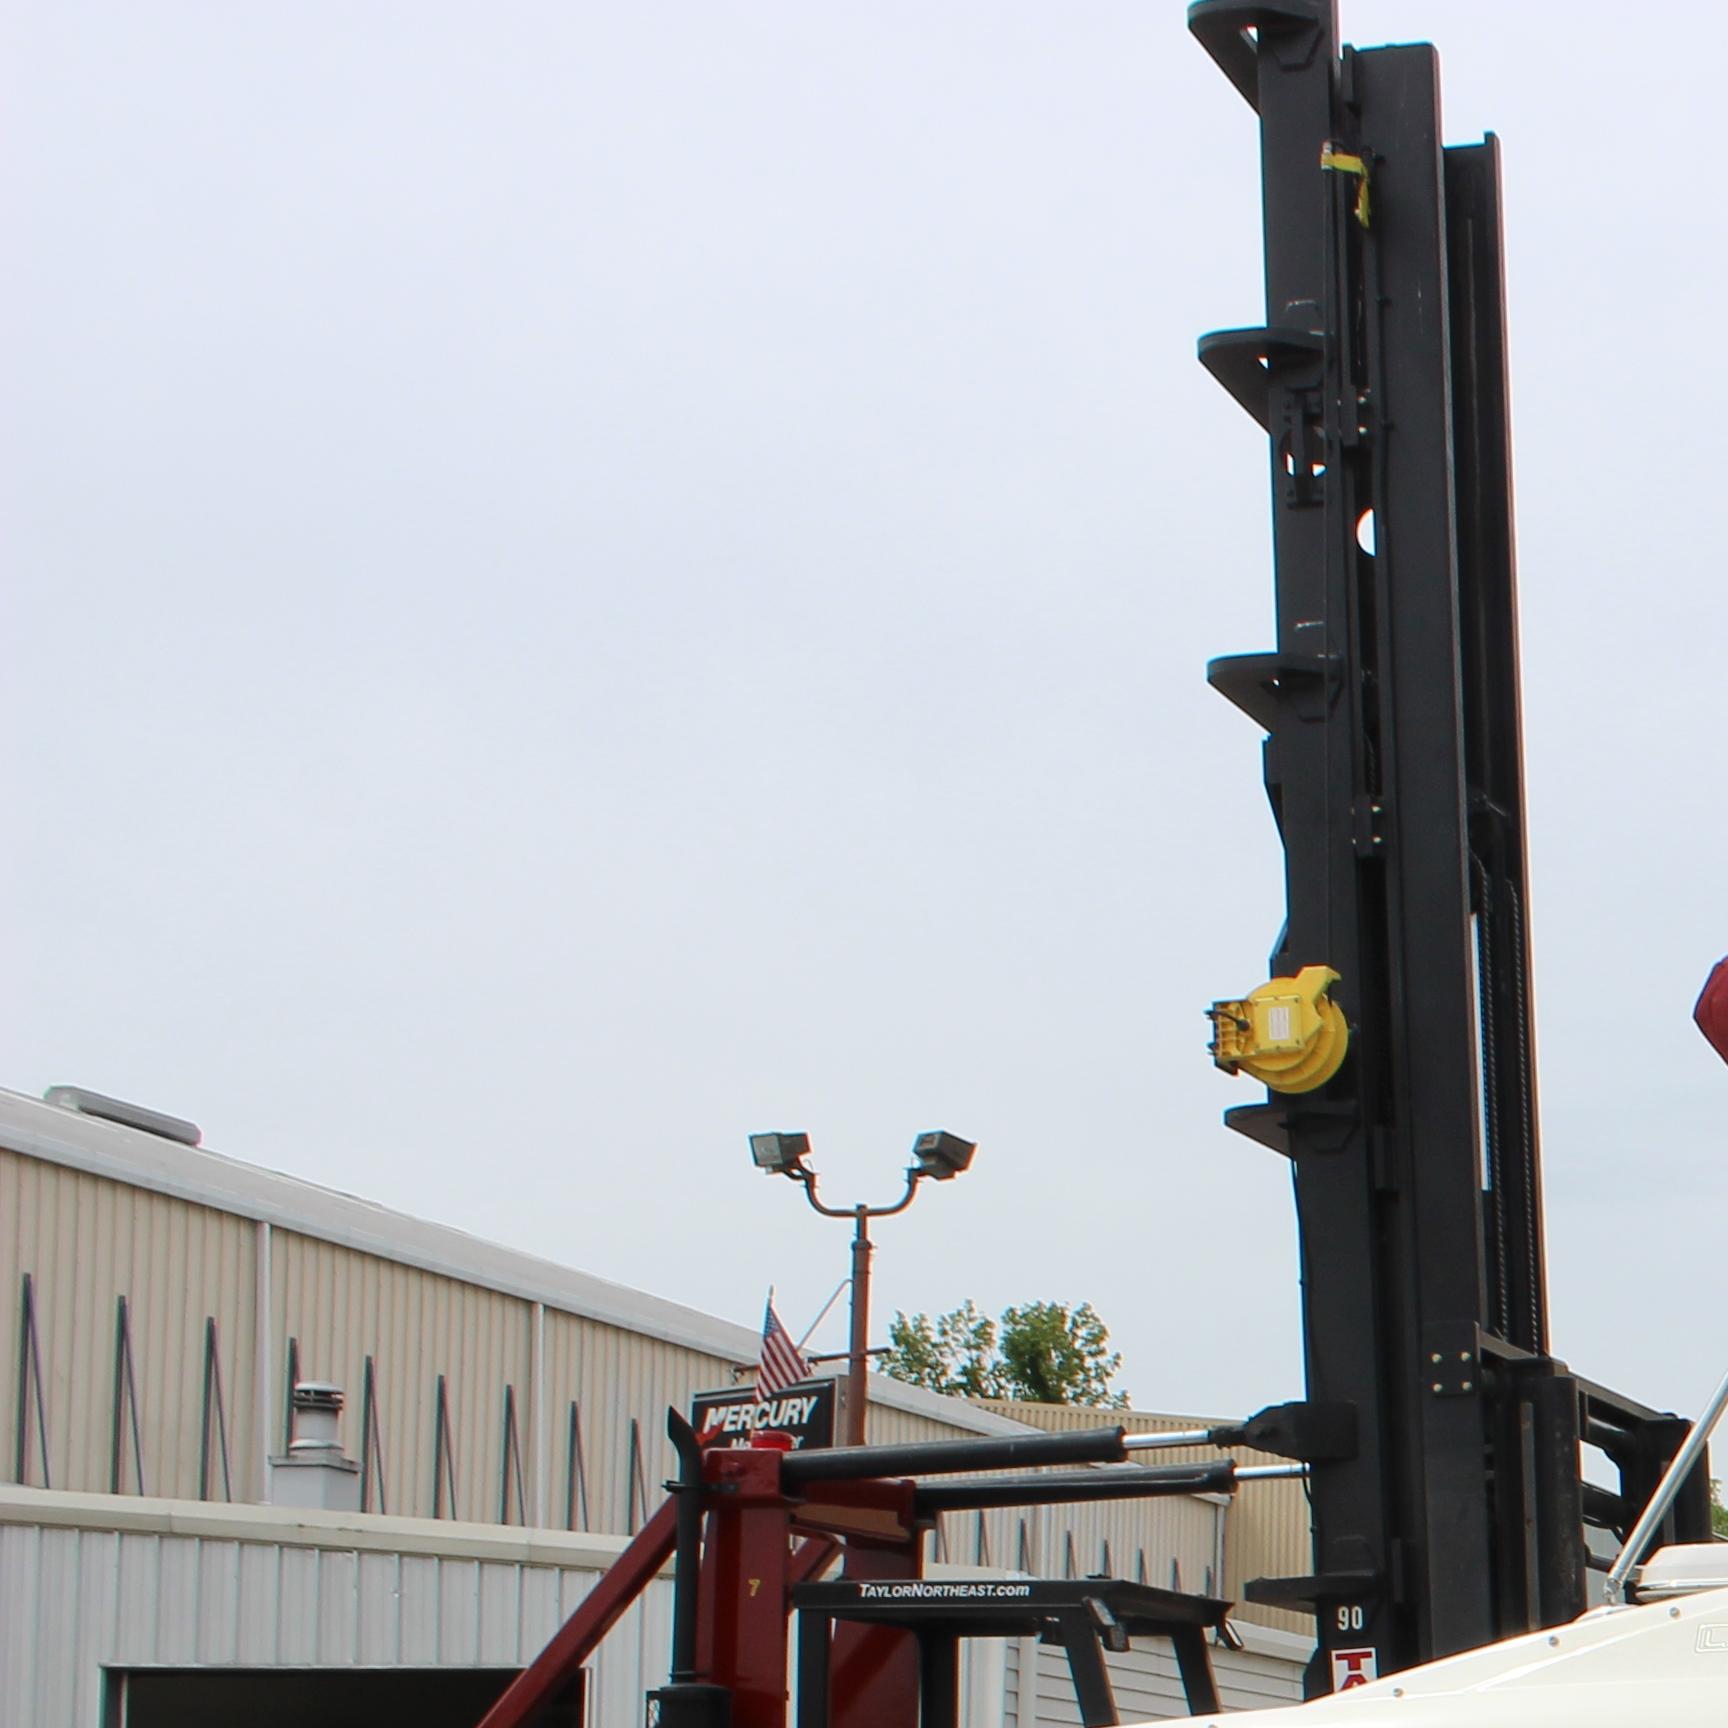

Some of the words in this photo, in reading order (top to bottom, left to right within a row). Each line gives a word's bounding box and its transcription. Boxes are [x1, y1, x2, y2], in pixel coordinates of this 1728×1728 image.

[702, 1396, 818, 1434] MERCURY
[748, 1579, 760, 1596] 7
[1338, 1606, 1363, 1631] 90
